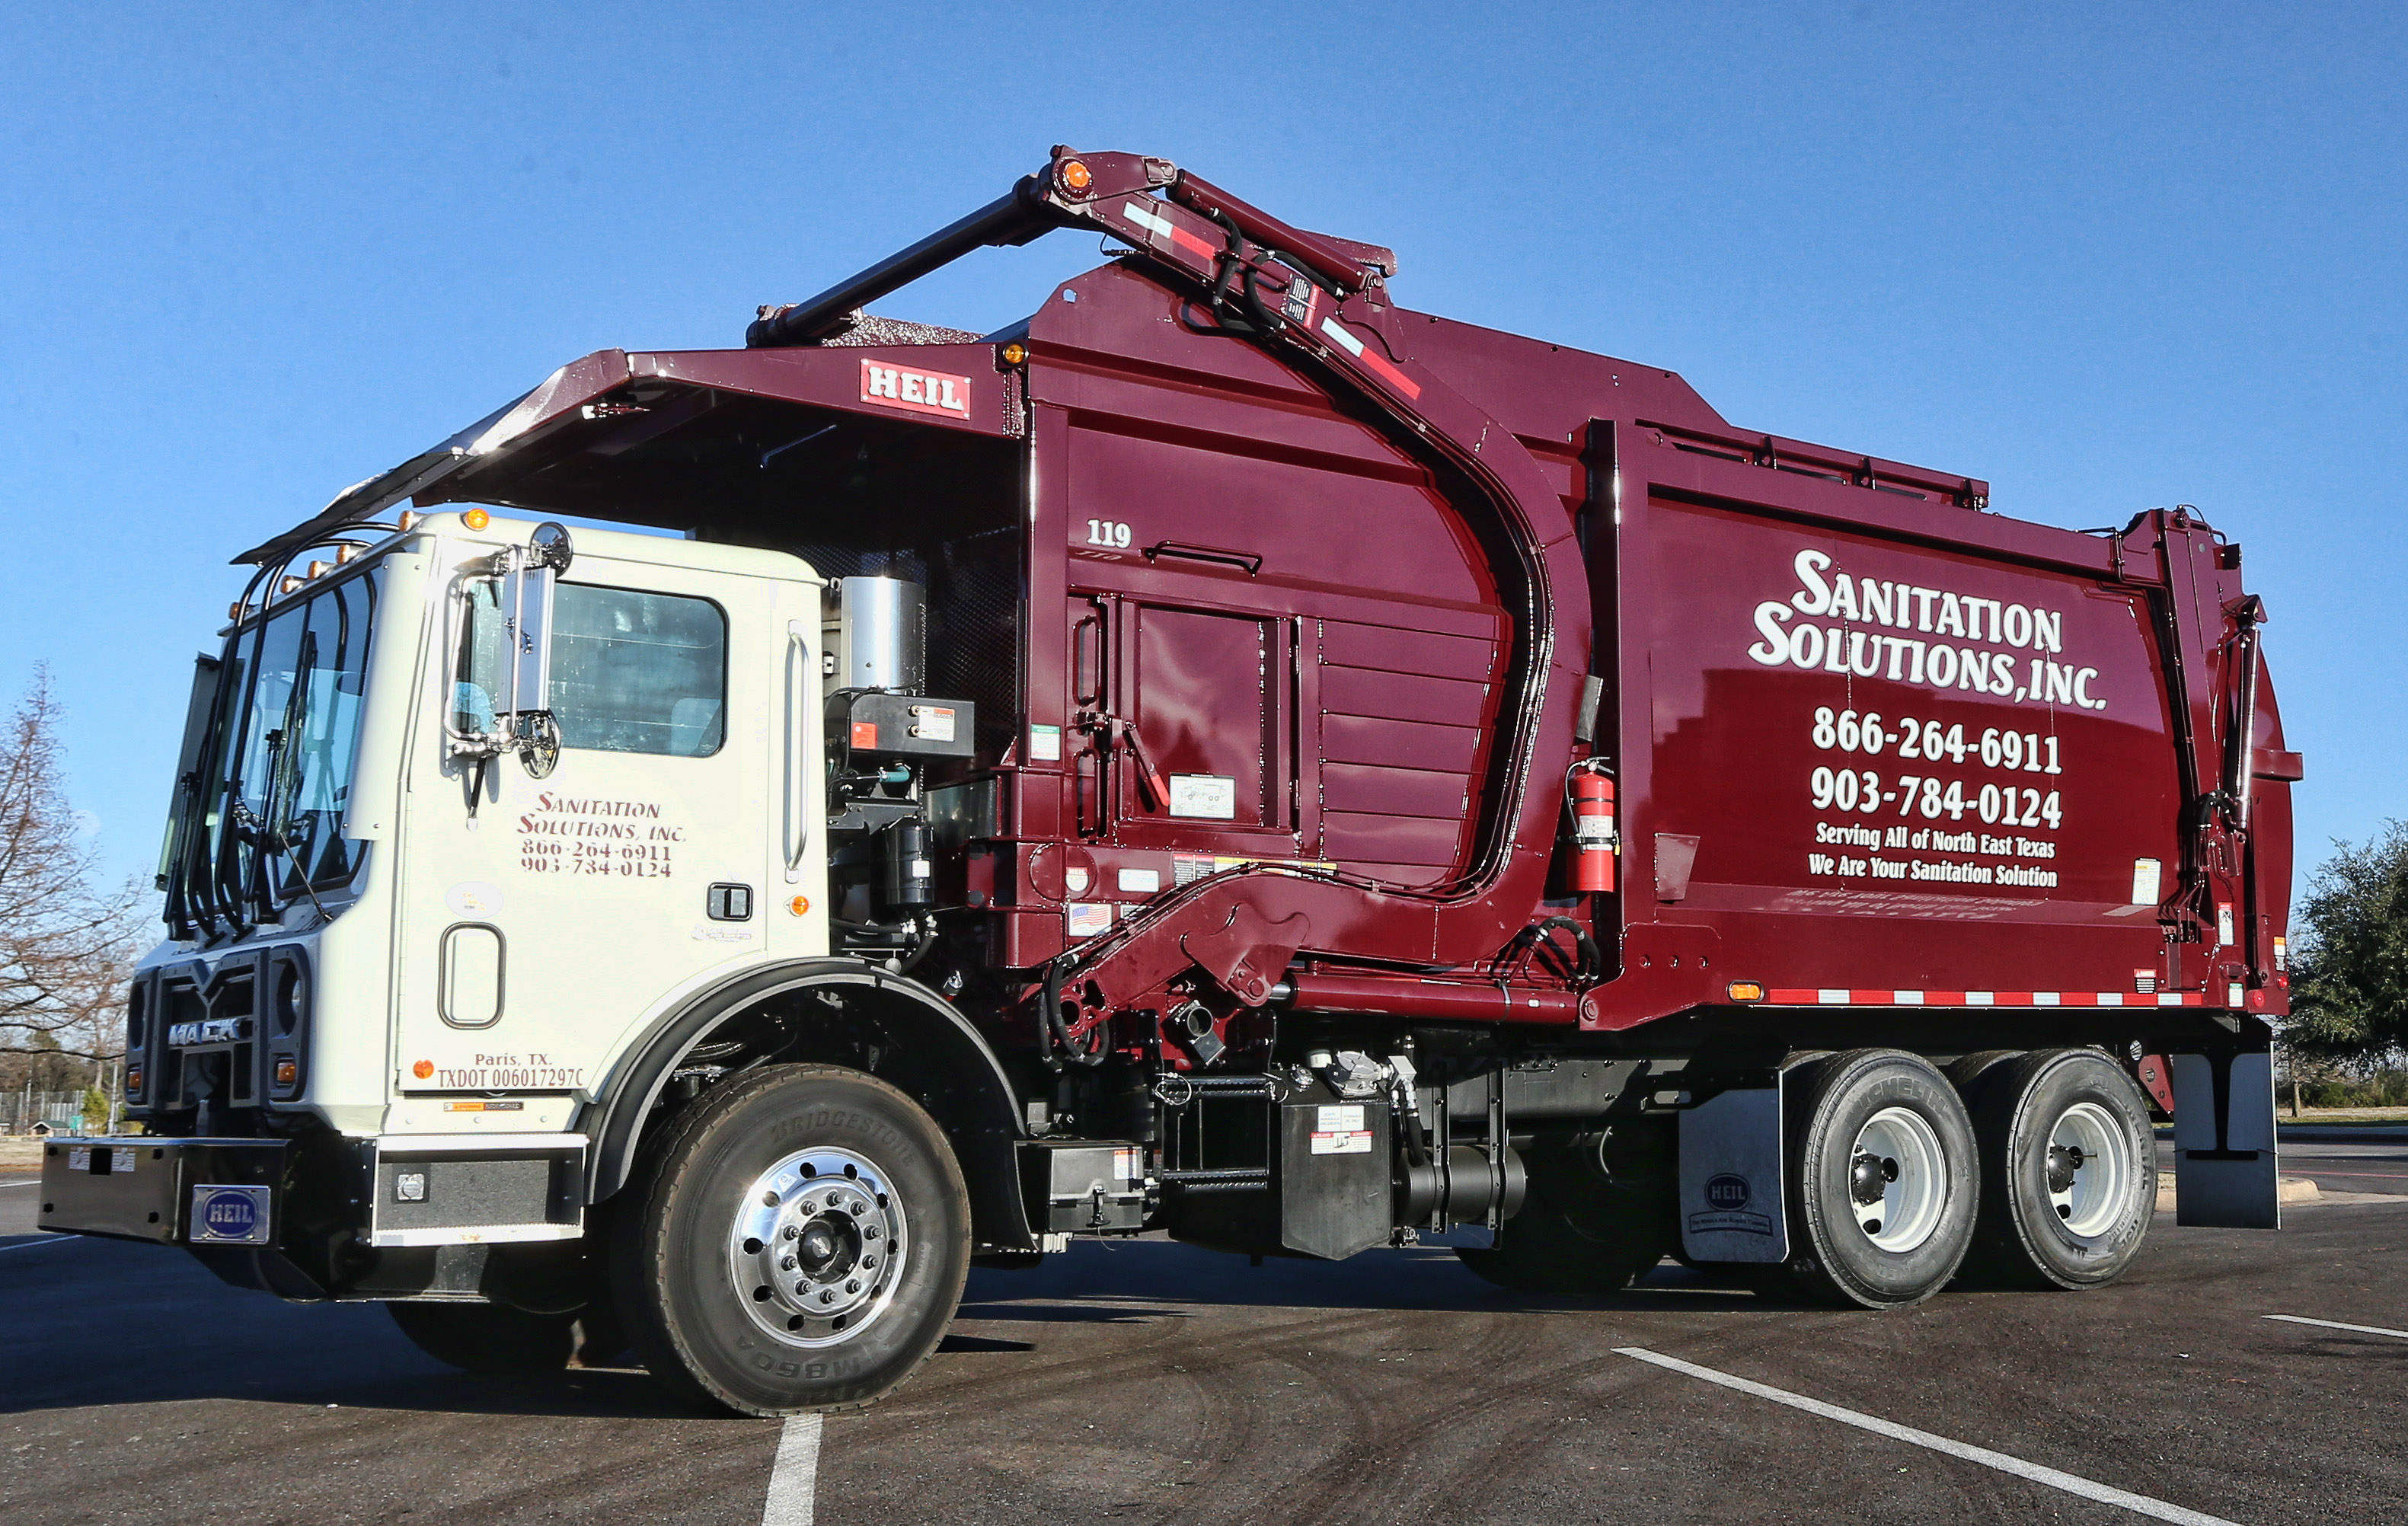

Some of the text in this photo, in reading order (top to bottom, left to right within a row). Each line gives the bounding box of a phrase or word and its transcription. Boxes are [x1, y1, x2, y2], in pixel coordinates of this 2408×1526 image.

[868, 366, 964, 410] HEIL
[1087, 519, 1132, 548] 119
[1790, 549, 2062, 653] SANITATION
[1811, 706, 2063, 774] 866-264-6911
[535, 791, 660, 818] SANITATION
[1810, 766, 2063, 830] 903-784-0124
[517, 813, 686, 841] SOLUTIONS, INC.
[1816, 822, 2056, 859] Serving All of North East Texas
[522, 838, 671, 861] 866-264-6911
[1808, 853, 2058, 888] We Are Your Sanitation Solution
[169, 1018, 240, 1046] MACK
[475, 1053, 552, 1067] Paris, TX.
[438, 1068, 583, 1087] TXDOT 006017297C
[771, 1110, 915, 1165] BRIDGESTONE
[1711, 1185, 1745, 1199] HEIL
[209, 1204, 252, 1224] HEIL
